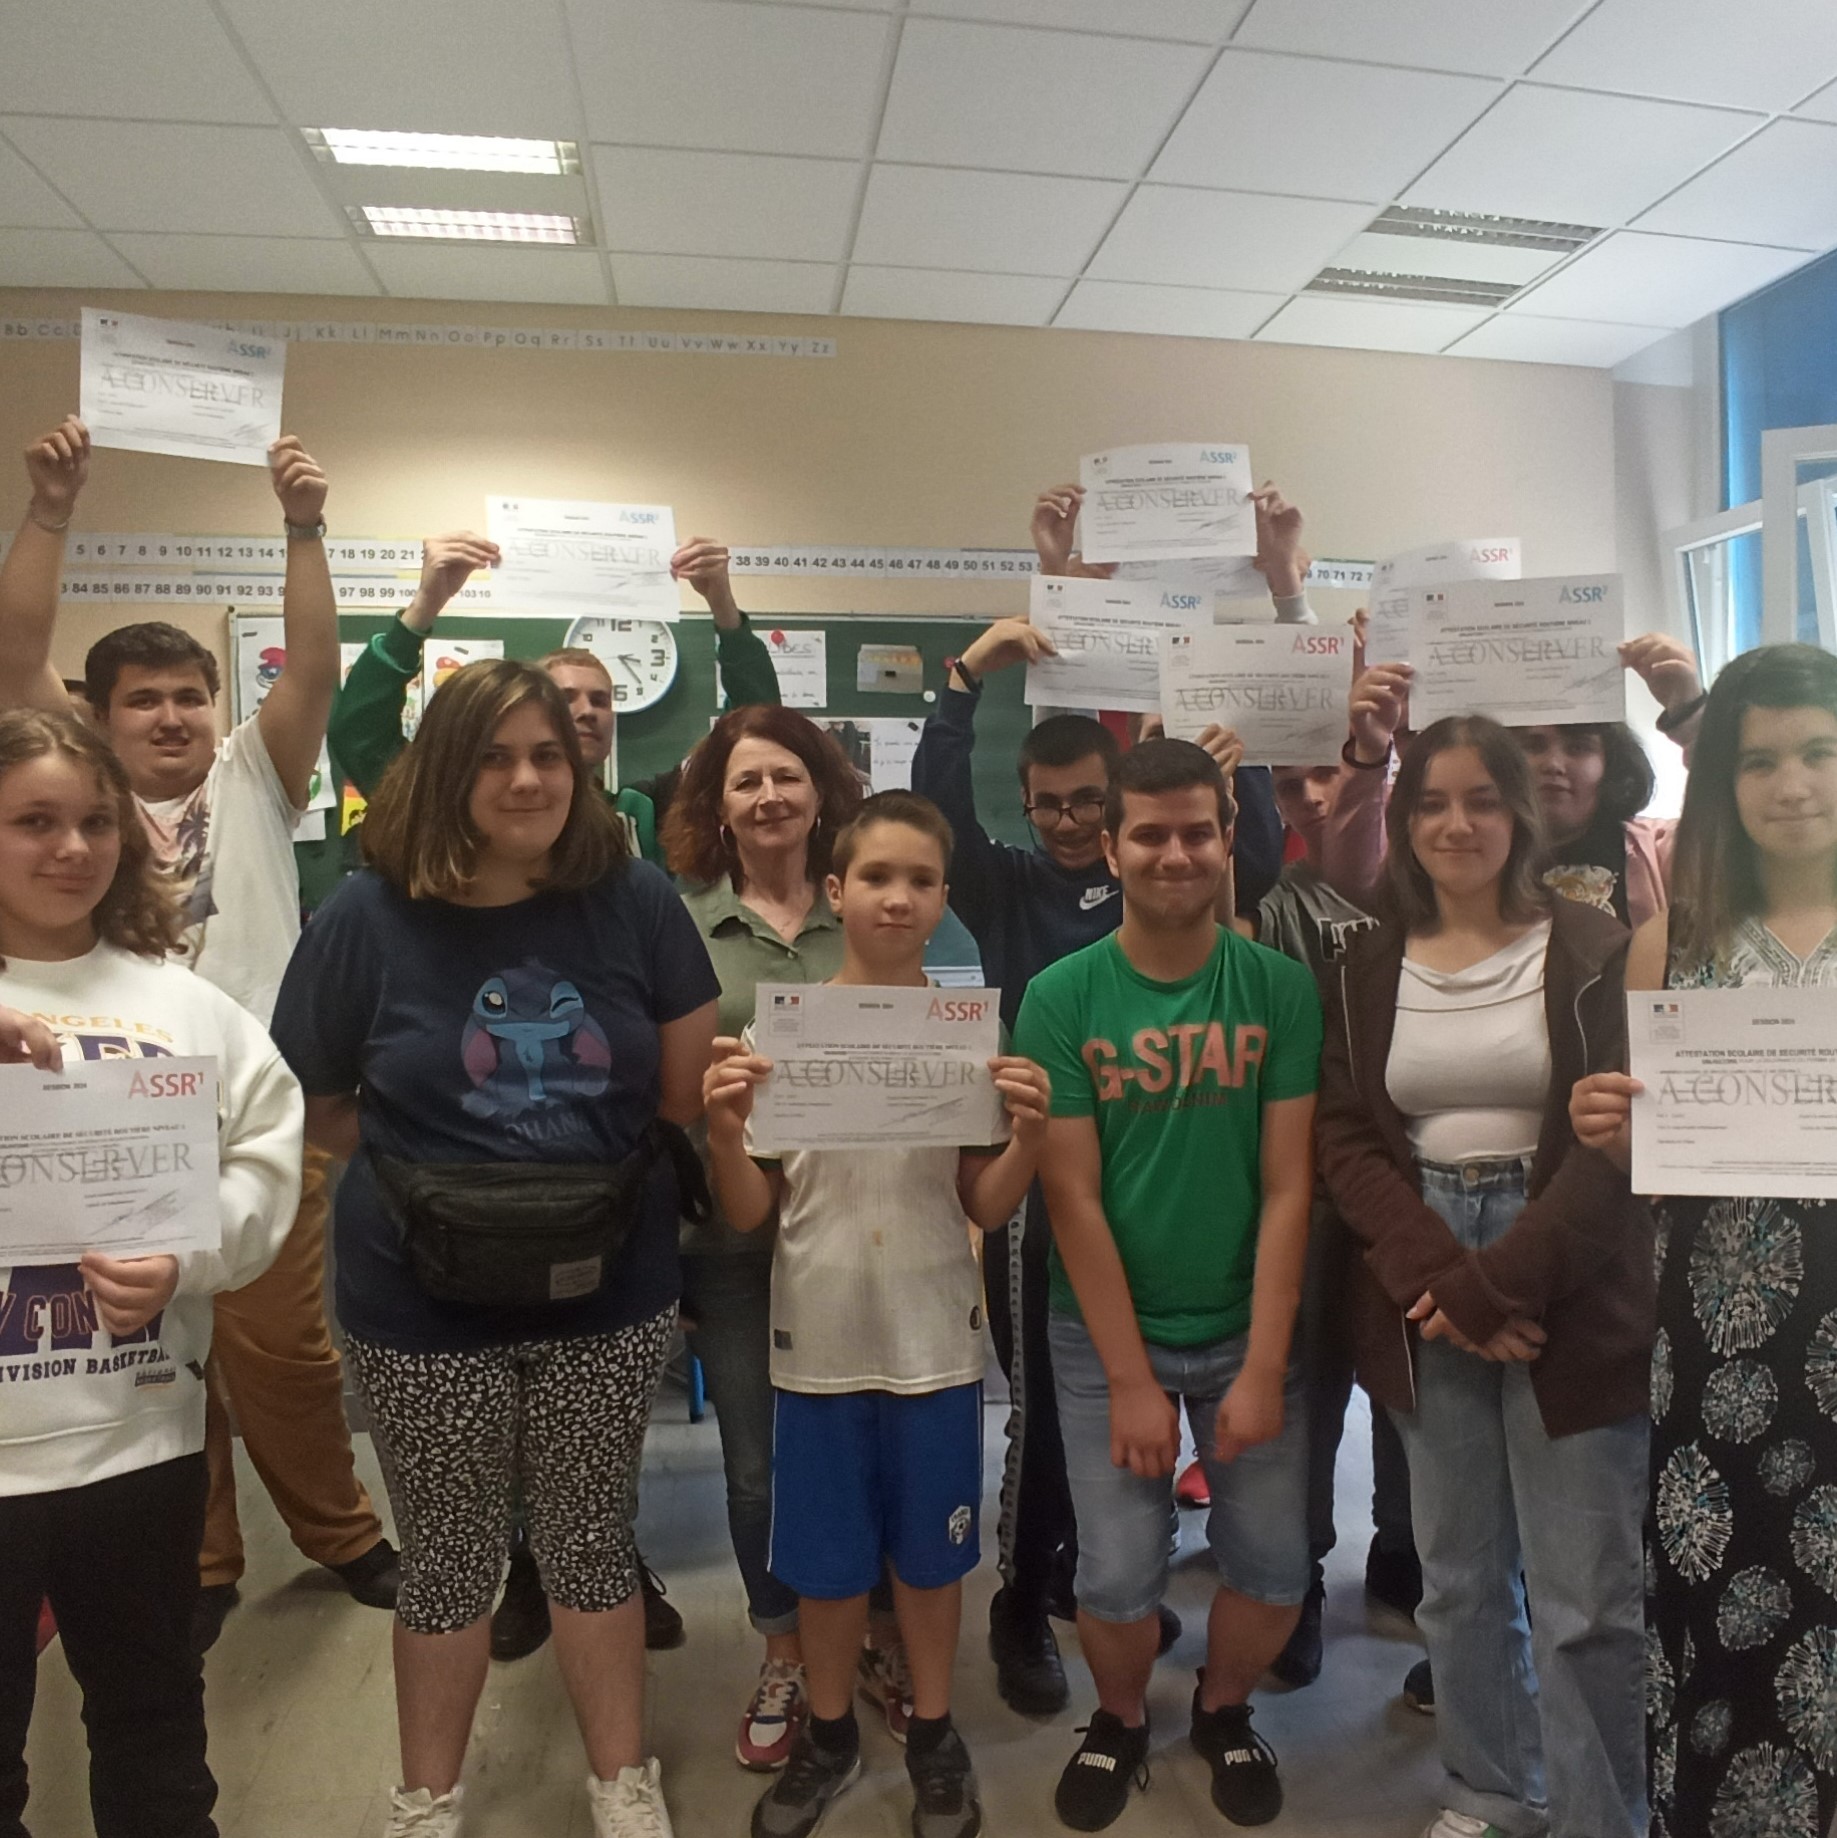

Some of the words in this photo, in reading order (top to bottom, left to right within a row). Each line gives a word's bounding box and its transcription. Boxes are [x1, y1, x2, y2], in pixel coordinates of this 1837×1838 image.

[379, 329, 410, 339] Mm
[415, 330, 439, 340] Nn
[448, 330, 474, 343] Oo
[484, 332, 505, 348] Pp
[649, 337, 670, 348] Uu
[710, 339, 738, 350] Ww
[77, 544, 85, 555] 5
[98, 545, 106, 555] 6
[118, 545, 126, 555] 7
[138, 546, 146, 556] 8
[176, 546, 192, 556] 10
[196, 547, 211, 557] 11
[218, 547, 232, 557] 12
[238, 547, 253, 557] 13
[259, 548, 273, 557] 14
[340, 549, 355, 559] 18
[360, 549, 375, 559] 19
[380, 549, 395, 559] 20
[401, 550, 414, 560] 21
[736, 556, 751, 566] 38
[755, 556, 770, 566] 39
[774, 557, 789, 567] 40
[793, 558, 807, 567] 41
[812, 558, 827, 568] 42
[831, 558, 846, 568] 43
[850, 559, 865, 568] 44
[869, 559, 884, 569] 45
[889, 559, 903, 569] 46
[907, 560, 922, 569] 47
[926, 560, 940, 569] 48
[945, 560, 959, 569] 49
[964, 560, 978, 570] 50
[982, 560, 995, 570] 51
[1000, 561, 1014, 571] 52
[1019, 562, 1032, 571] 53
[1318, 570, 1330, 579] 70
[1333, 570, 1345, 580] 71
[1351, 572, 1362, 581] 72
[72, 583, 88, 593] 84
[93, 583, 109, 594] 85
[114, 583, 130, 594] 86
[135, 584, 151, 594] 87
[155, 584, 170, 594] 88
[175, 584, 191, 594] 89
[196, 584, 212, 595] 90
[216, 585, 231, 595] 91
[237, 585, 253, 596] 92
[257, 586, 273, 596] 93
[339, 587, 355, 597] 97
[360, 588, 375, 597] 98
[380, 588, 395, 597] 99
[399, 589, 417, 598] 100
[650, 649, 665, 667] 3
[614, 685, 628, 701] 6
[32, 1012, 174, 1043] NGELES
[806, 1060, 975, 1089] CONSERVER
[1078, 1752, 1117, 1772] PUMA
